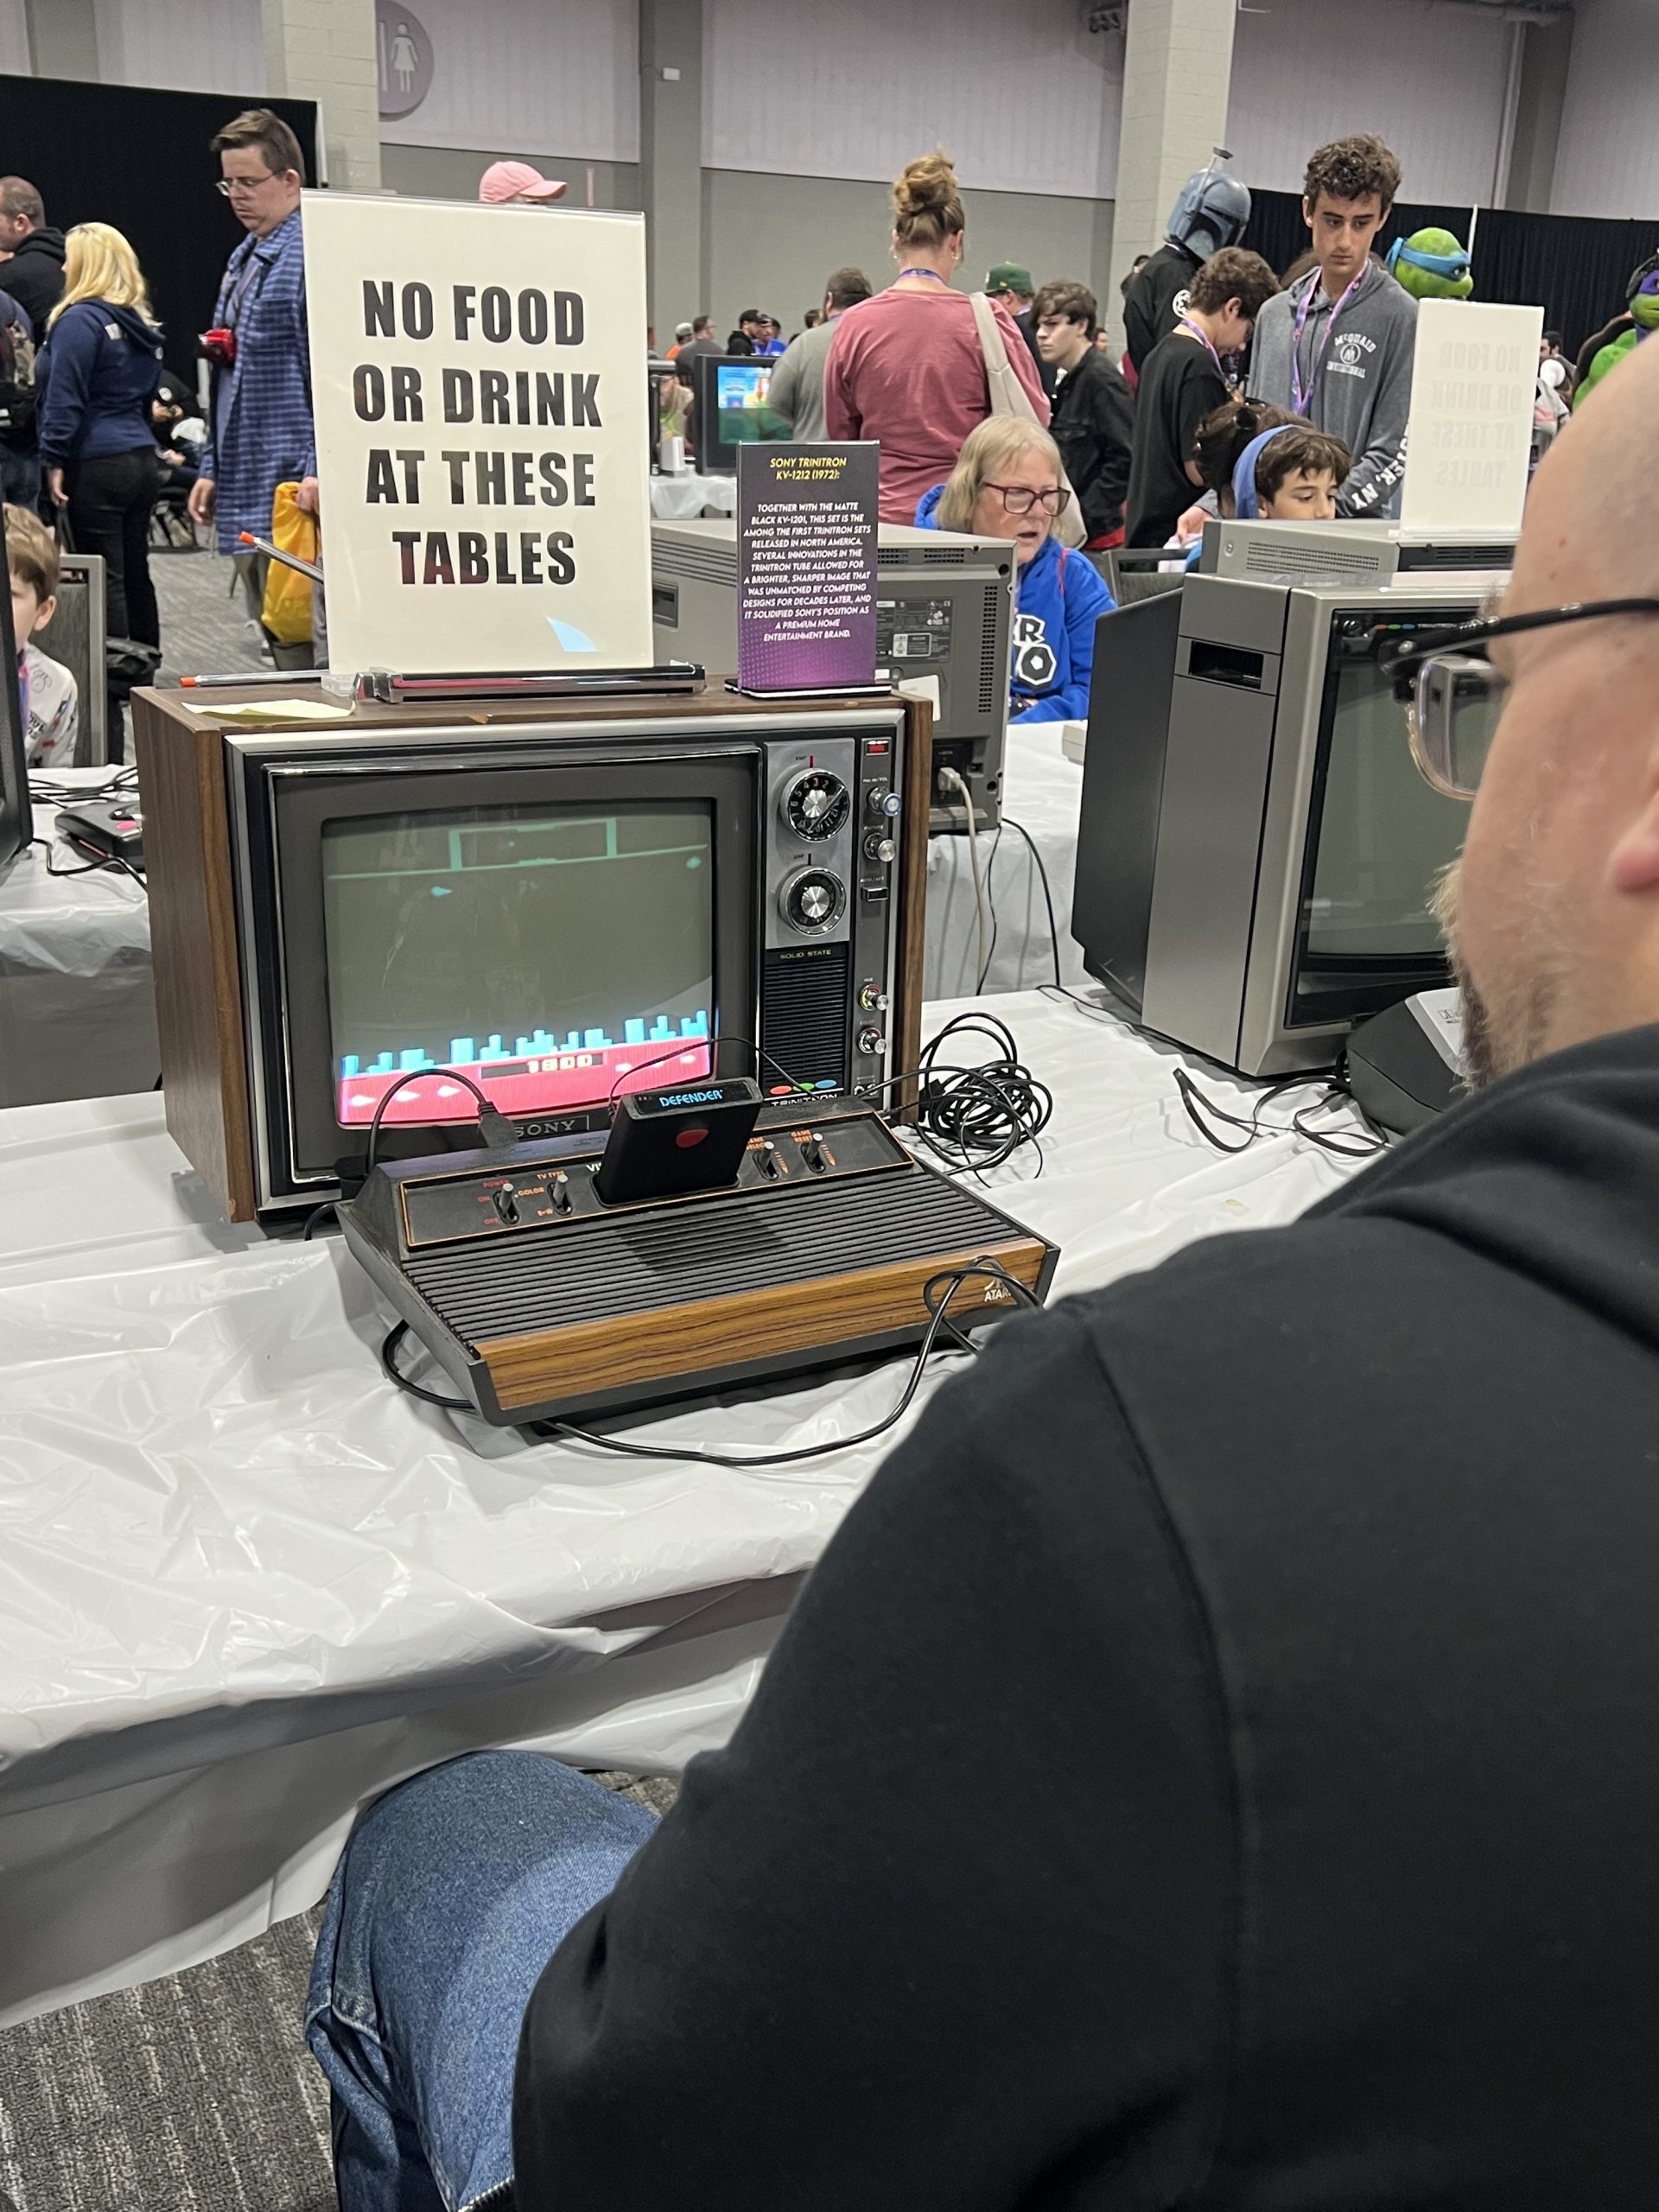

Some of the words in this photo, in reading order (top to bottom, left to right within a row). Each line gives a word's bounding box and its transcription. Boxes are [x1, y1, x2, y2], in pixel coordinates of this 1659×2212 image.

[363, 280, 433, 340] NO
[453, 285, 583, 346] FOOD
[353, 364, 423, 422] OR
[442, 368, 602, 427] DRINK
[770, 458, 796, 468] SONY
[799, 457, 847, 467] TRINITRON
[366, 449, 424, 504] AT
[442, 450, 595, 506] THESE
[776, 470, 810, 480] KV-1212
[812, 470, 840, 480] (1972):
[1351, 483, 1379, 510] NY
[758, 503, 797, 513] TOGETHER
[798, 503, 817, 512] WITH
[820, 503, 833, 511] THE
[834, 502, 859, 511] MATTE
[751, 516, 775, 525] BLACK
[810, 515, 826, 523] THIS
[827, 514, 840, 523] SET
[841, 514, 849, 523] IS
[851, 514, 864, 522] THE
[743, 528, 774, 537] AMONG
[776, 527, 790, 536] THE
[792, 527, 812, 535] FIRST
[814, 526, 853, 535] TRINITRON
[854, 525, 871, 534] SETS
[751, 540, 789, 548] RELEASED
[790, 539, 799, 547] IN
[800, 538, 827, 547] NORTH
[827, 537, 863, 546] AMERICA.
[392, 531, 575, 585] TABLES
[753, 552, 786, 560] SEVERAL
[788, 550, 838, 559] INNOVATIONS
[849, 549, 863, 557] THE
[751, 563, 791, 572] TRINITRON
[793, 562, 811, 571] TUBE
[812, 561, 848, 570] ALLOWED
[849, 561, 864, 569] FOR
[751, 575, 790, 584] BRIGHTER,
[792, 574, 826, 583] SHARPER
[827, 572, 851, 581] IMAGE
[852, 571, 871, 580] THAT
[748, 588, 763, 596] WAS
[765, 586, 812, 595] UNMATCHED
[813, 585, 822, 594] BY
[823, 583, 866, 593] COMPETING
[743, 599, 775, 608] DESIGNS
[777, 598, 792, 606] FOR
[794, 597, 828, 605] DECADES
[854, 595, 871, 603] AND
[744, 611, 752, 619] IT
[753, 610, 793, 619] SOLIDIFIED
[795, 608, 822, 617] SONY'S
[823, 607, 858, 616] POSITION
[782, 620, 817, 629] PREMIUM
[818, 619, 840, 627] HOME
[763, 631, 823, 641] ENTERTAINMENT
[813, 778, 819, 787] 3
[527, 1053, 592, 1074] 1800
[659, 1090, 723, 1107] DEFENDER
[514, 1119, 576, 1138] SONY
